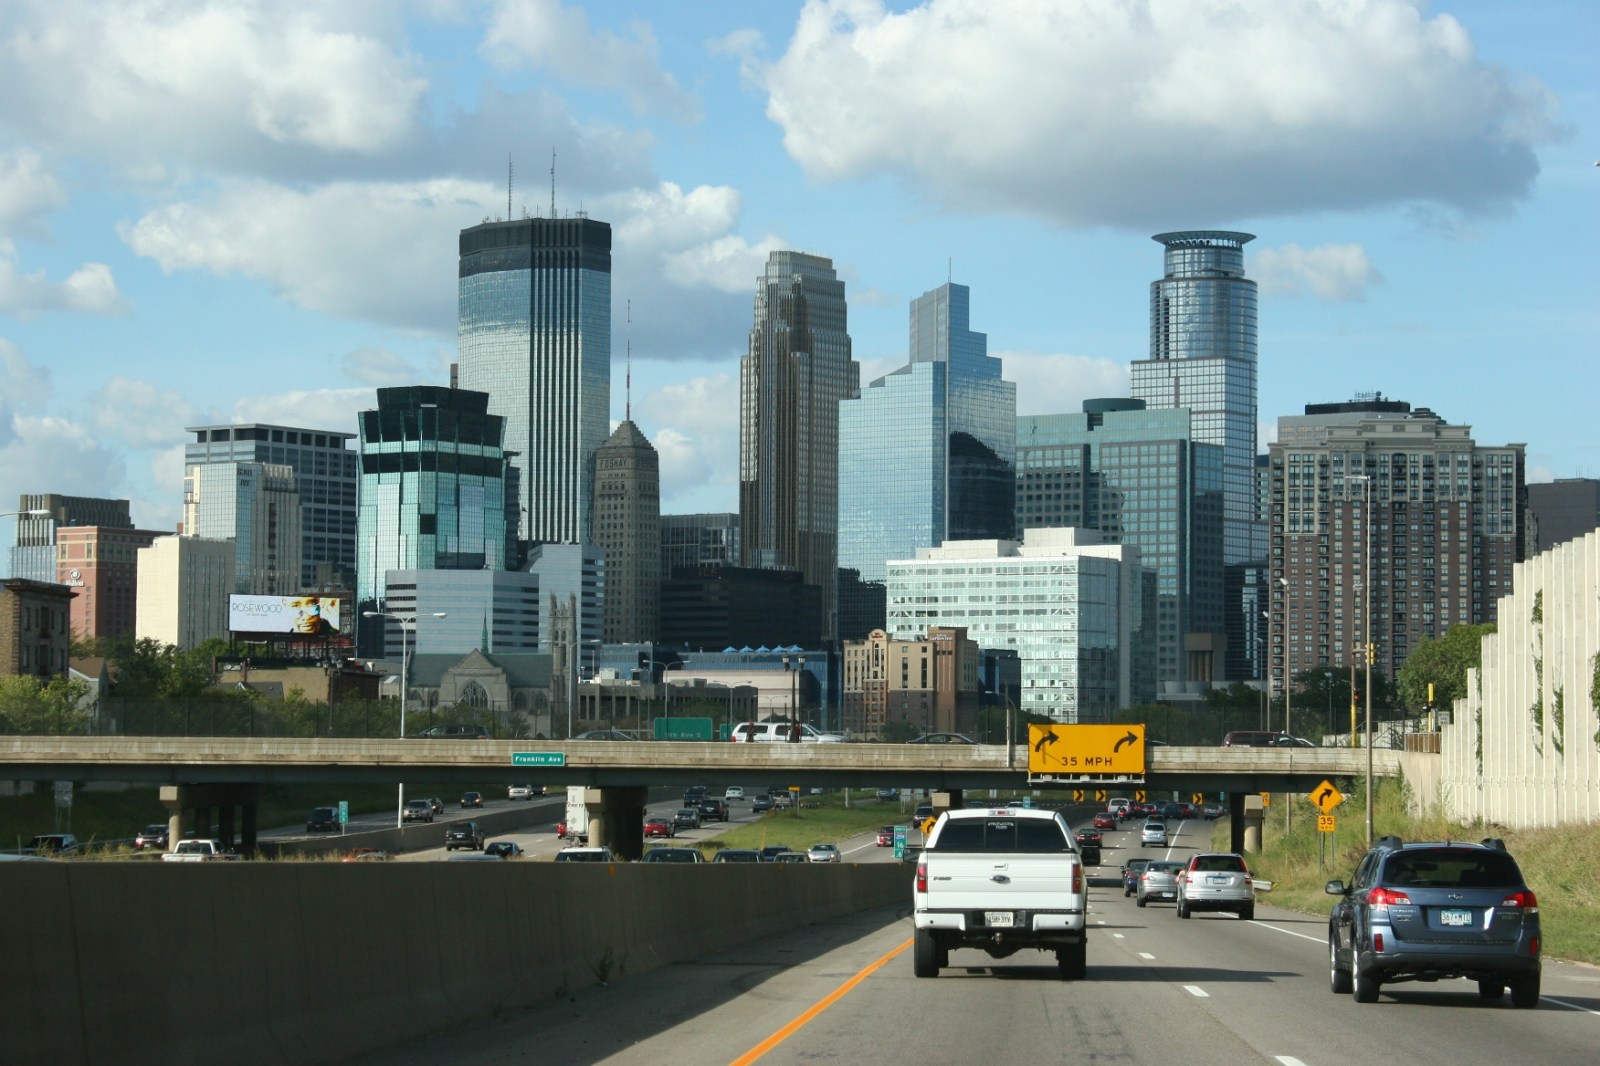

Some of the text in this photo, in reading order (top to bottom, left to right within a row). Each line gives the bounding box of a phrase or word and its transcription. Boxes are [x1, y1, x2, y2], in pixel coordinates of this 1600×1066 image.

[600, 459, 627, 468] FOSHAY
[232, 602, 282, 613] ROSEWOOD
[1061, 757, 1113, 766] 35 MPH
[1320, 817, 1333, 825] 35
